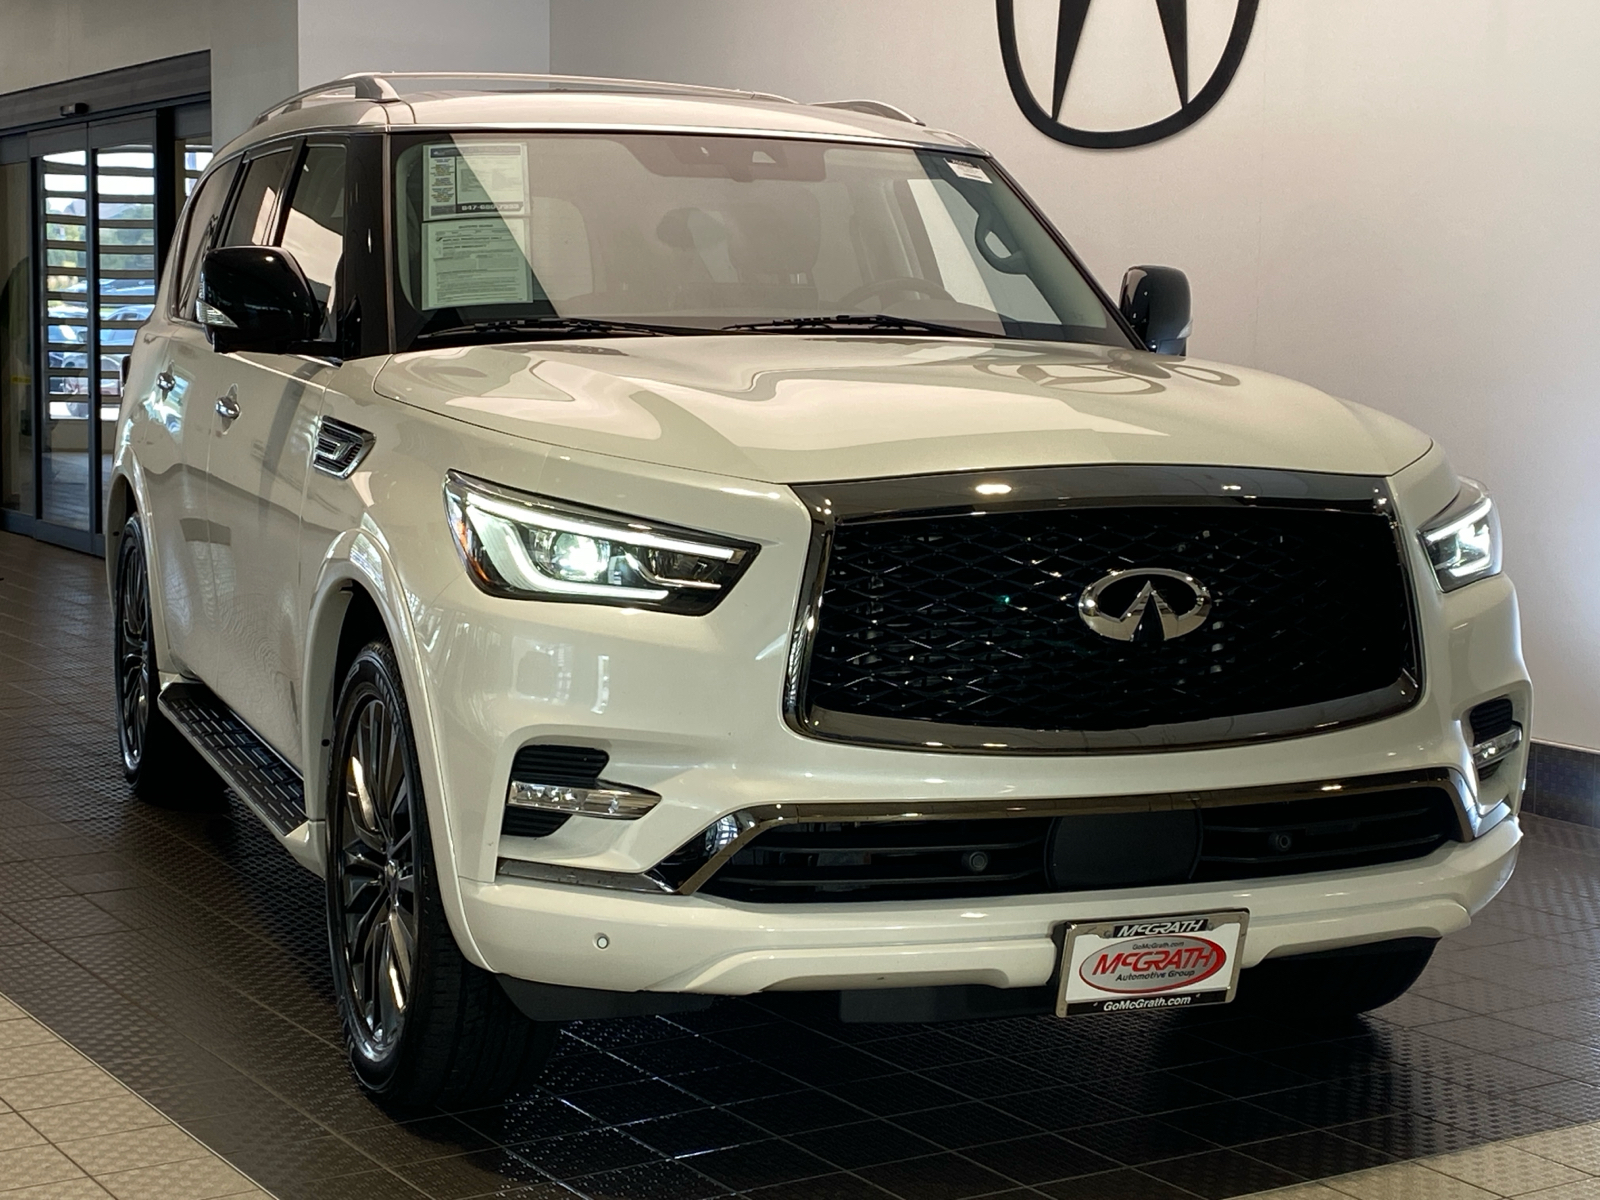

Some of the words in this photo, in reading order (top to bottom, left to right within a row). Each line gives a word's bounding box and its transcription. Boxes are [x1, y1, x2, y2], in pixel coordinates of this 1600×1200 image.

[1117, 919, 1204, 937] McGRATH
[1132, 941, 1184, 950] GoMcGrath.com
[1092, 947, 1215, 975] McGRATH
[1115, 971, 1166, 982] Automotive
[1167, 970, 1196, 979] Group
[1103, 996, 1192, 1011] GoMcGrath.com
